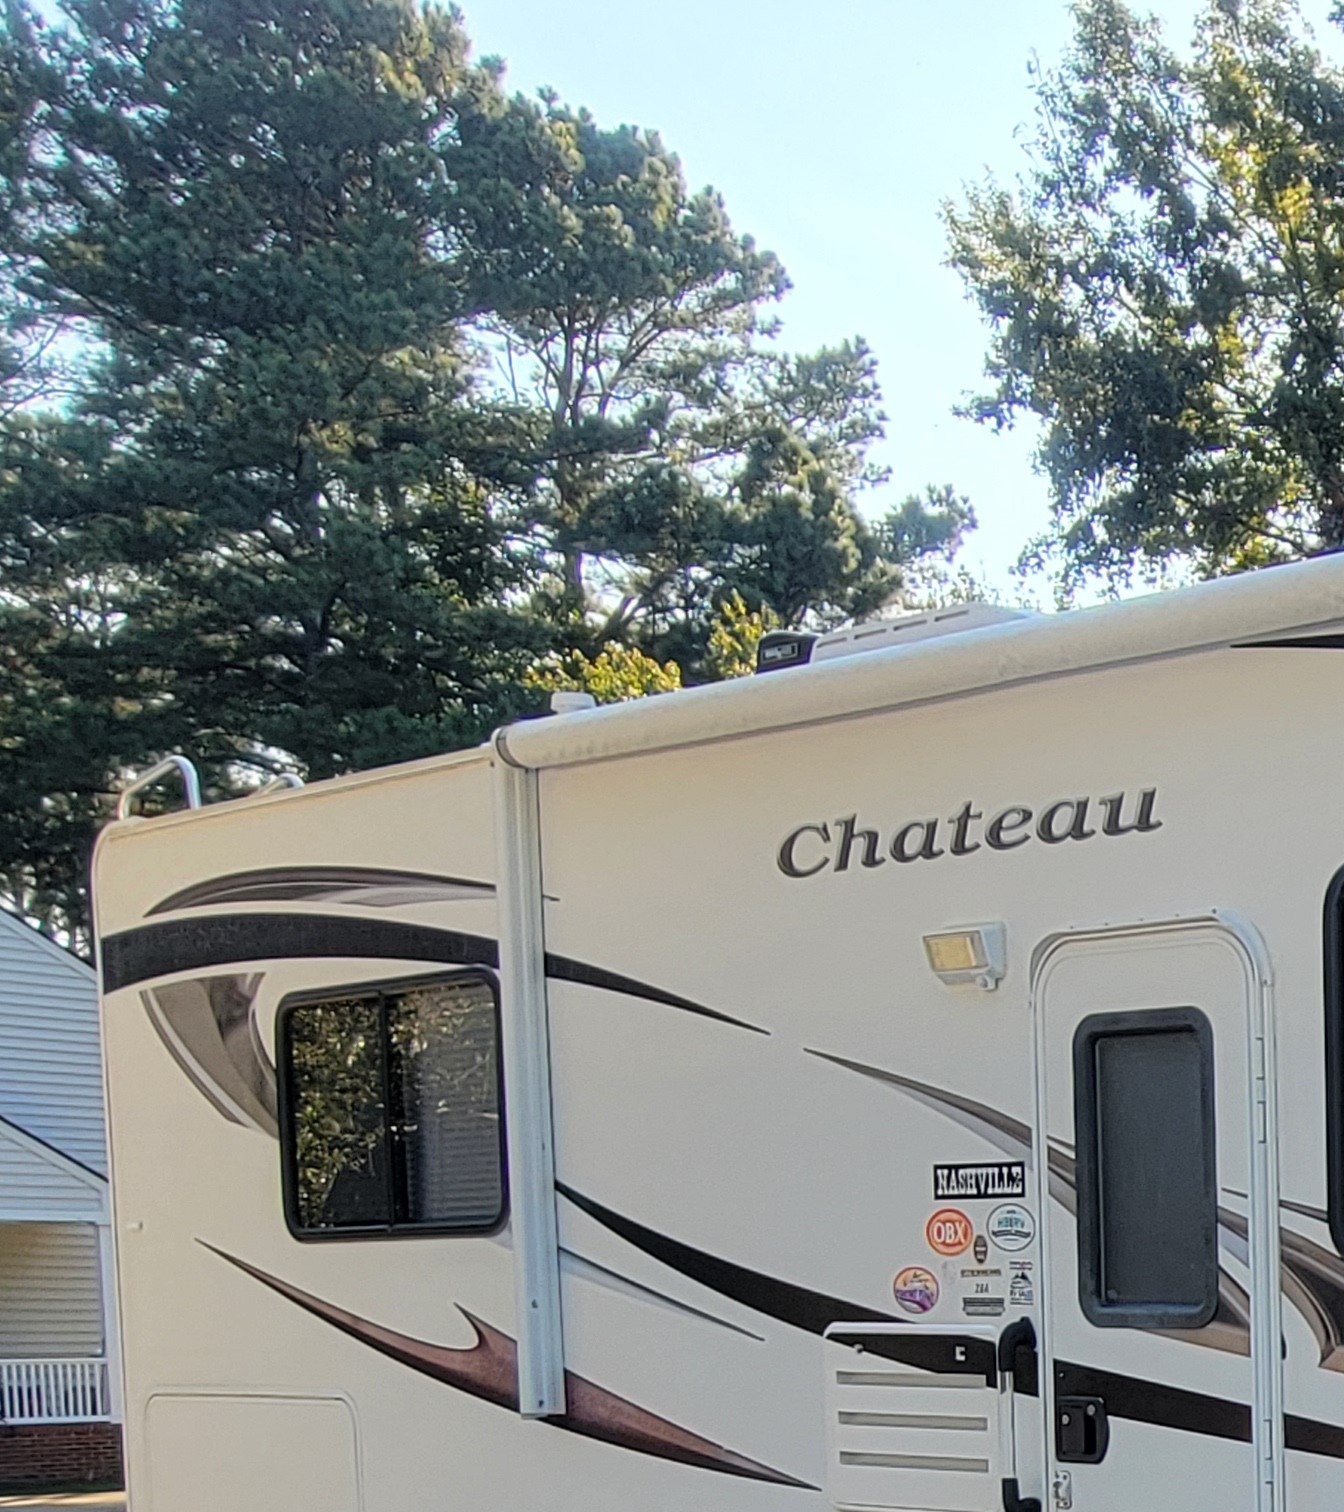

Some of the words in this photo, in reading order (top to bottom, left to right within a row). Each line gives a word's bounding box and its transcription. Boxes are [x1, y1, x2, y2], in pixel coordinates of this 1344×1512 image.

[776, 786, 1163, 878] Chateau
[937, 1166, 1022, 1195] NASHVILLE
[933, 1221, 967, 1244] OBX
